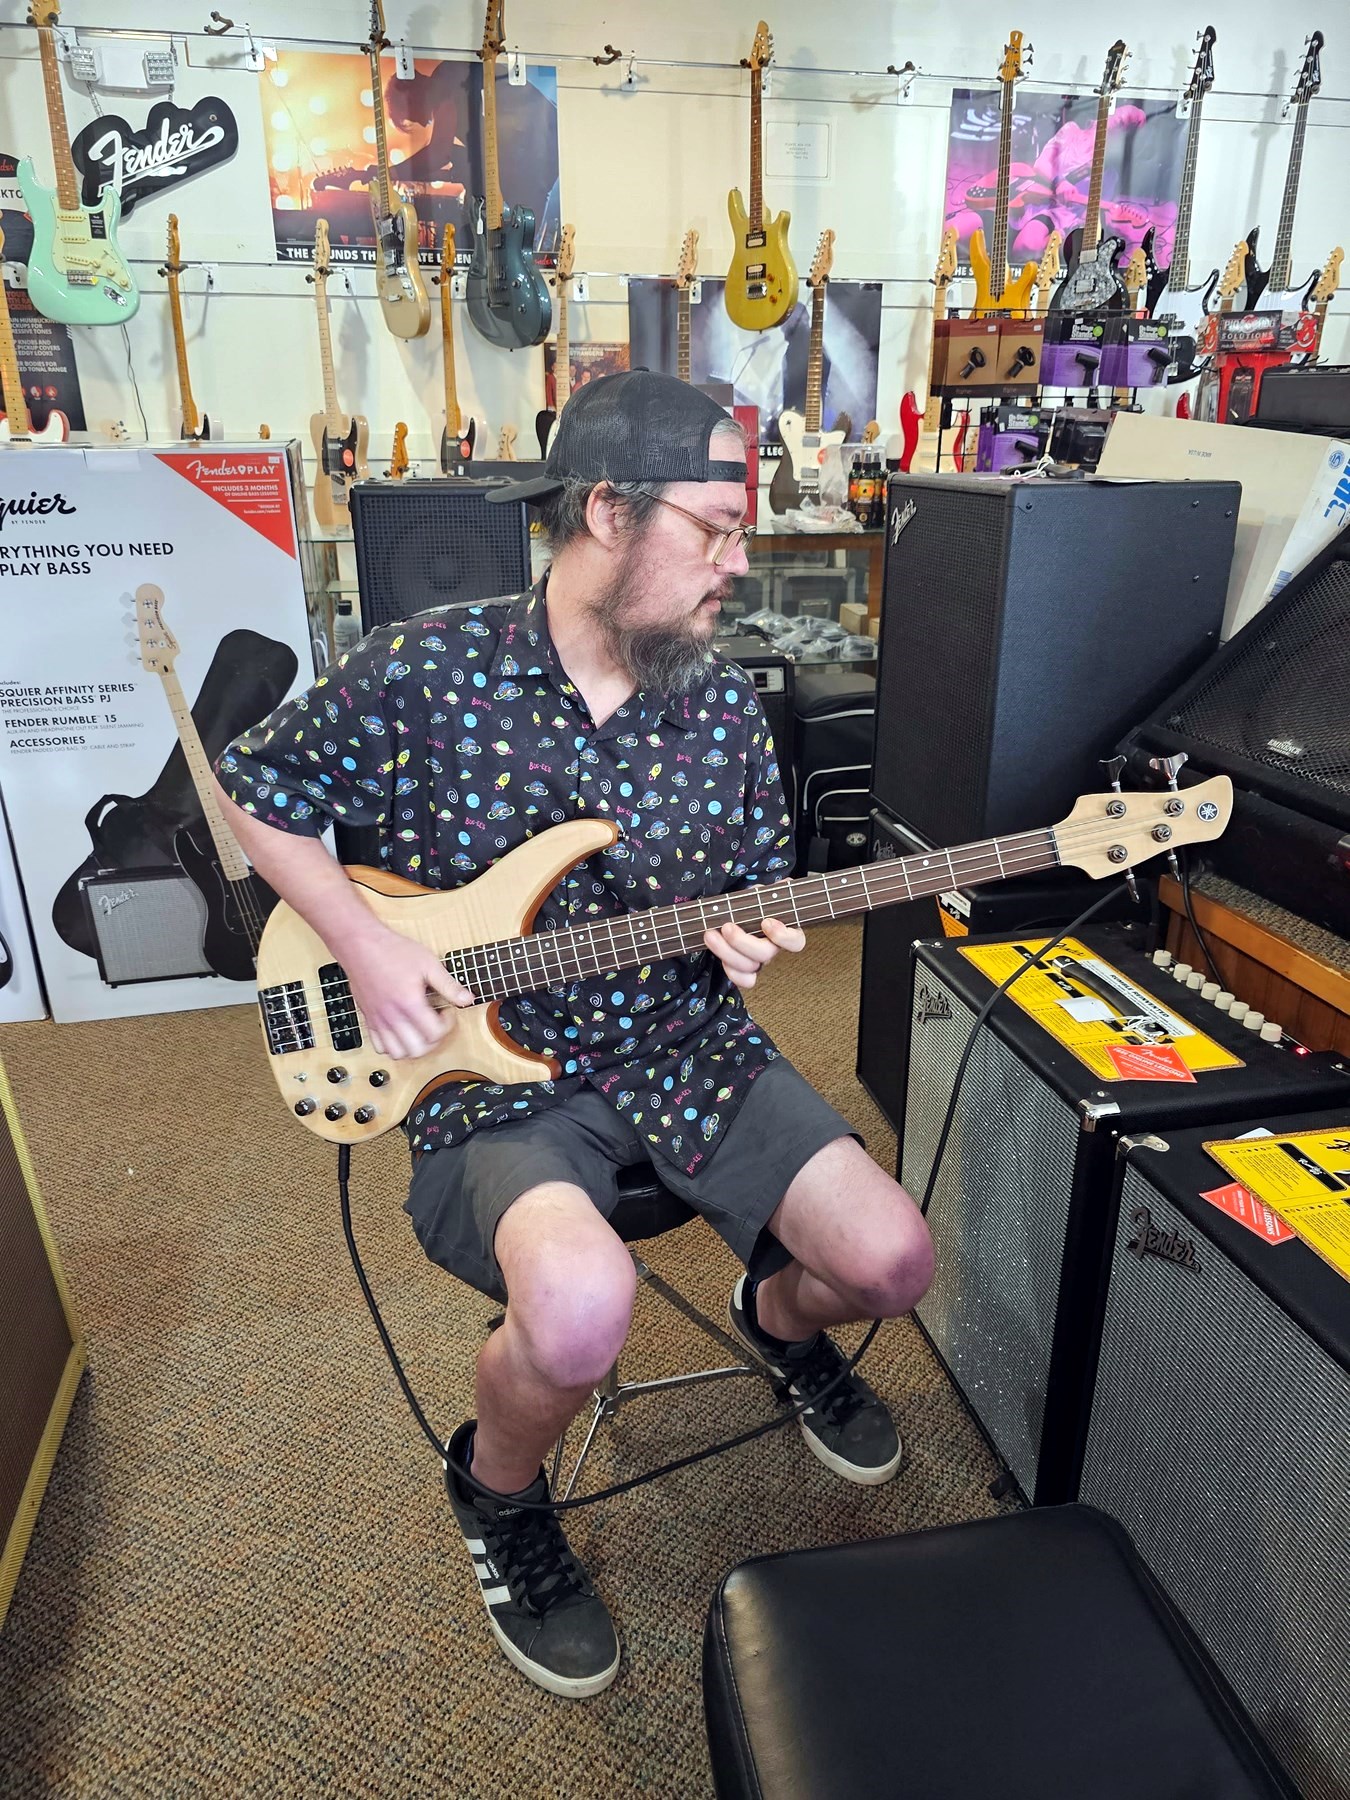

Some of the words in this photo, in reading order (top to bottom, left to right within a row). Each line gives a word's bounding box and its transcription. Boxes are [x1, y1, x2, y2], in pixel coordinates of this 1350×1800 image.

[88, 118, 225, 198] Fender
[286, 247, 308, 259] THE
[311, 248, 359, 261] SUNDS
[361, 249, 377, 261] TH
[1221, 330, 1274, 340] SOLUTIONS
[186, 459, 238, 479] Fender
[247, 465, 275, 475] PLAY
[890, 499, 917, 546] Fender
[0, 544, 80, 559] RYTHING
[85, 543, 124, 558] YOU
[128, 542, 174, 556] NEED
[0, 562, 41, 577] PLAY
[47, 561, 91, 575] BASS
[0, 687, 42, 698] SQUIER
[45, 685, 95, 696] AFFINITY
[98, 683, 135, 693] SERIES
[1, 696, 63, 708] PRECISION
[66, 694, 95, 705] BASS
[100, 694, 111, 703] PJ
[5, 717, 49, 728] FENDER
[52, 714, 98, 725] RUMBLE
[105, 714, 117, 723] 15
[10, 735, 86, 749] ACCESSORIES
[98, 888, 140, 916] Fender
[917, 983, 952, 1024] Fender
[1126, 1205, 1201, 1274] Fender
